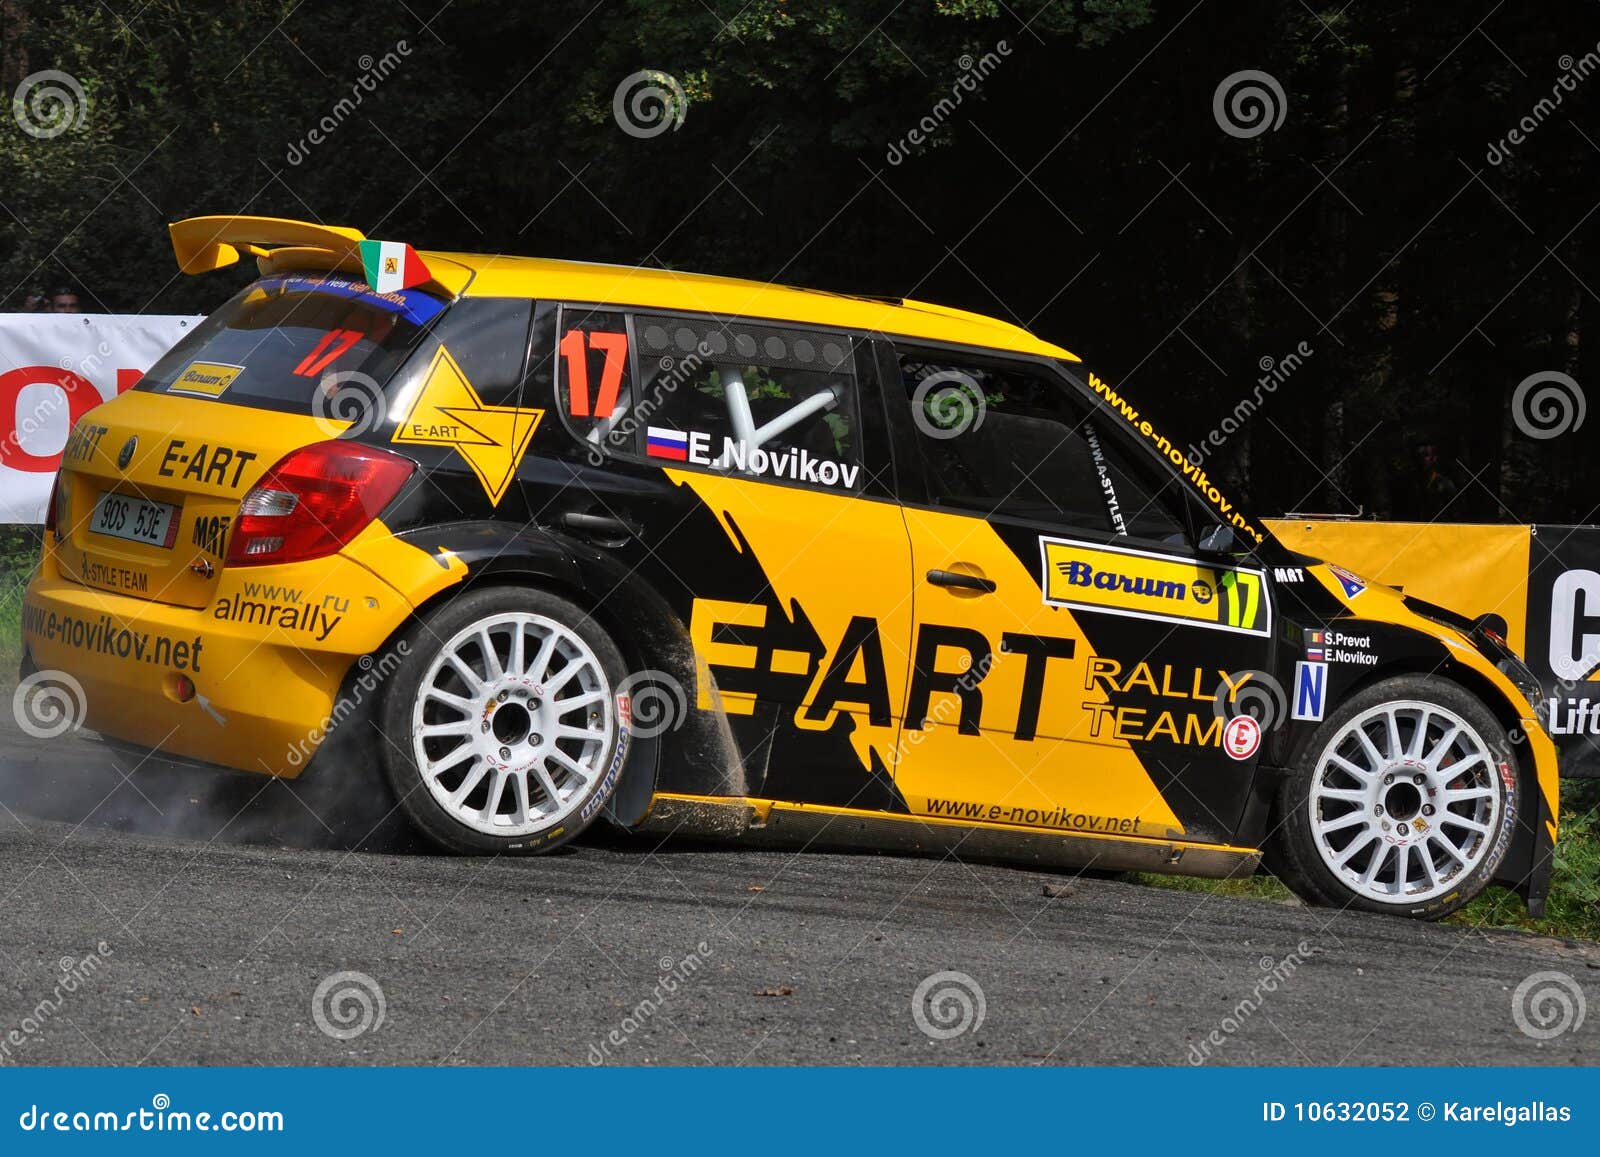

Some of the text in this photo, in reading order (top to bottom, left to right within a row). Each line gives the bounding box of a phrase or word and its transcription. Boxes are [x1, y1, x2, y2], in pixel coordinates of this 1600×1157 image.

[293, 328, 364, 377] 17
[560, 329, 628, 418] 17
[413, 424, 458, 438] E-ART
[158, 440, 257, 488] E-ART
[688, 431, 859, 488] E.Novikov
[118, 569, 148, 593] TEAM
[1057, 561, 1187, 601] Barum
[1222, 570, 1260, 629] 17
[1274, 568, 1305, 583] MAT
[214, 595, 341, 641] almrally
[323, 592, 350, 612] ru
[1325, 632, 1371, 648] S.Prevot
[1325, 648, 1378, 665] E.Novikov
[690, 597, 1075, 742] E-ART
[1084, 656, 1254, 704] RALLY
[1298, 664, 1324, 717] N
[1082, 701, 1225, 748] TEAM
[926, 797, 1141, 834] www.e-novikov.net
